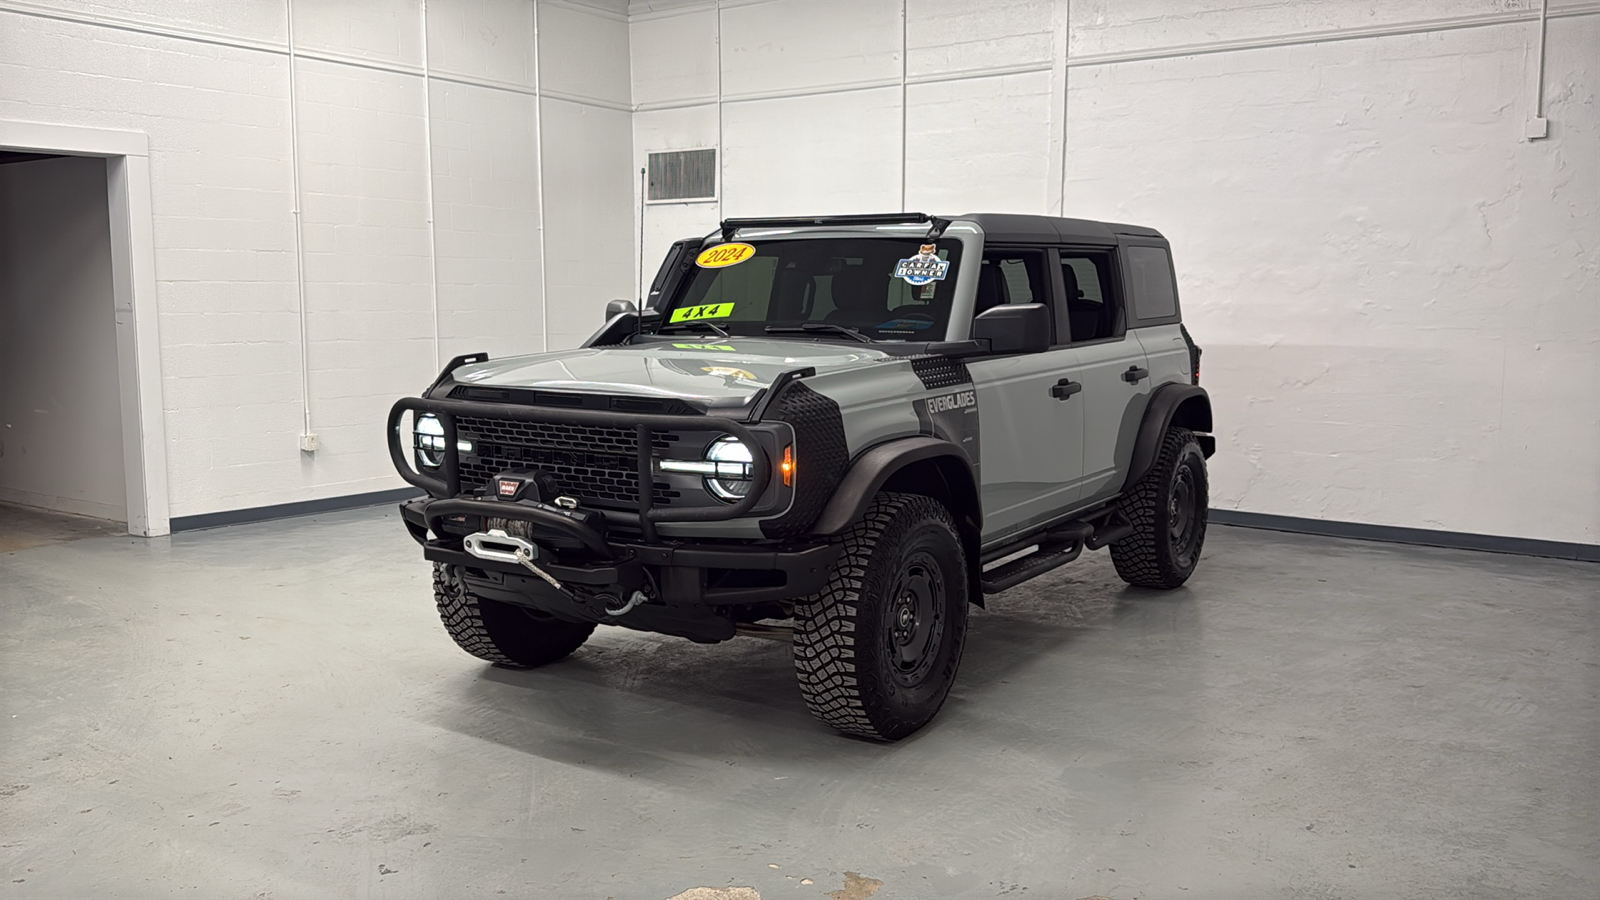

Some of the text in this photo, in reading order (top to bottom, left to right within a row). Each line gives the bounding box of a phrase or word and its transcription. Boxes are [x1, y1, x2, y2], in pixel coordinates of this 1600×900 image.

[703, 246, 747, 264] 2024
[901, 261, 945, 270] CARFAX
[906, 269, 942, 277] OWNER
[682, 304, 720, 318] 4X4
[927, 391, 975, 413] EVERGLADES
